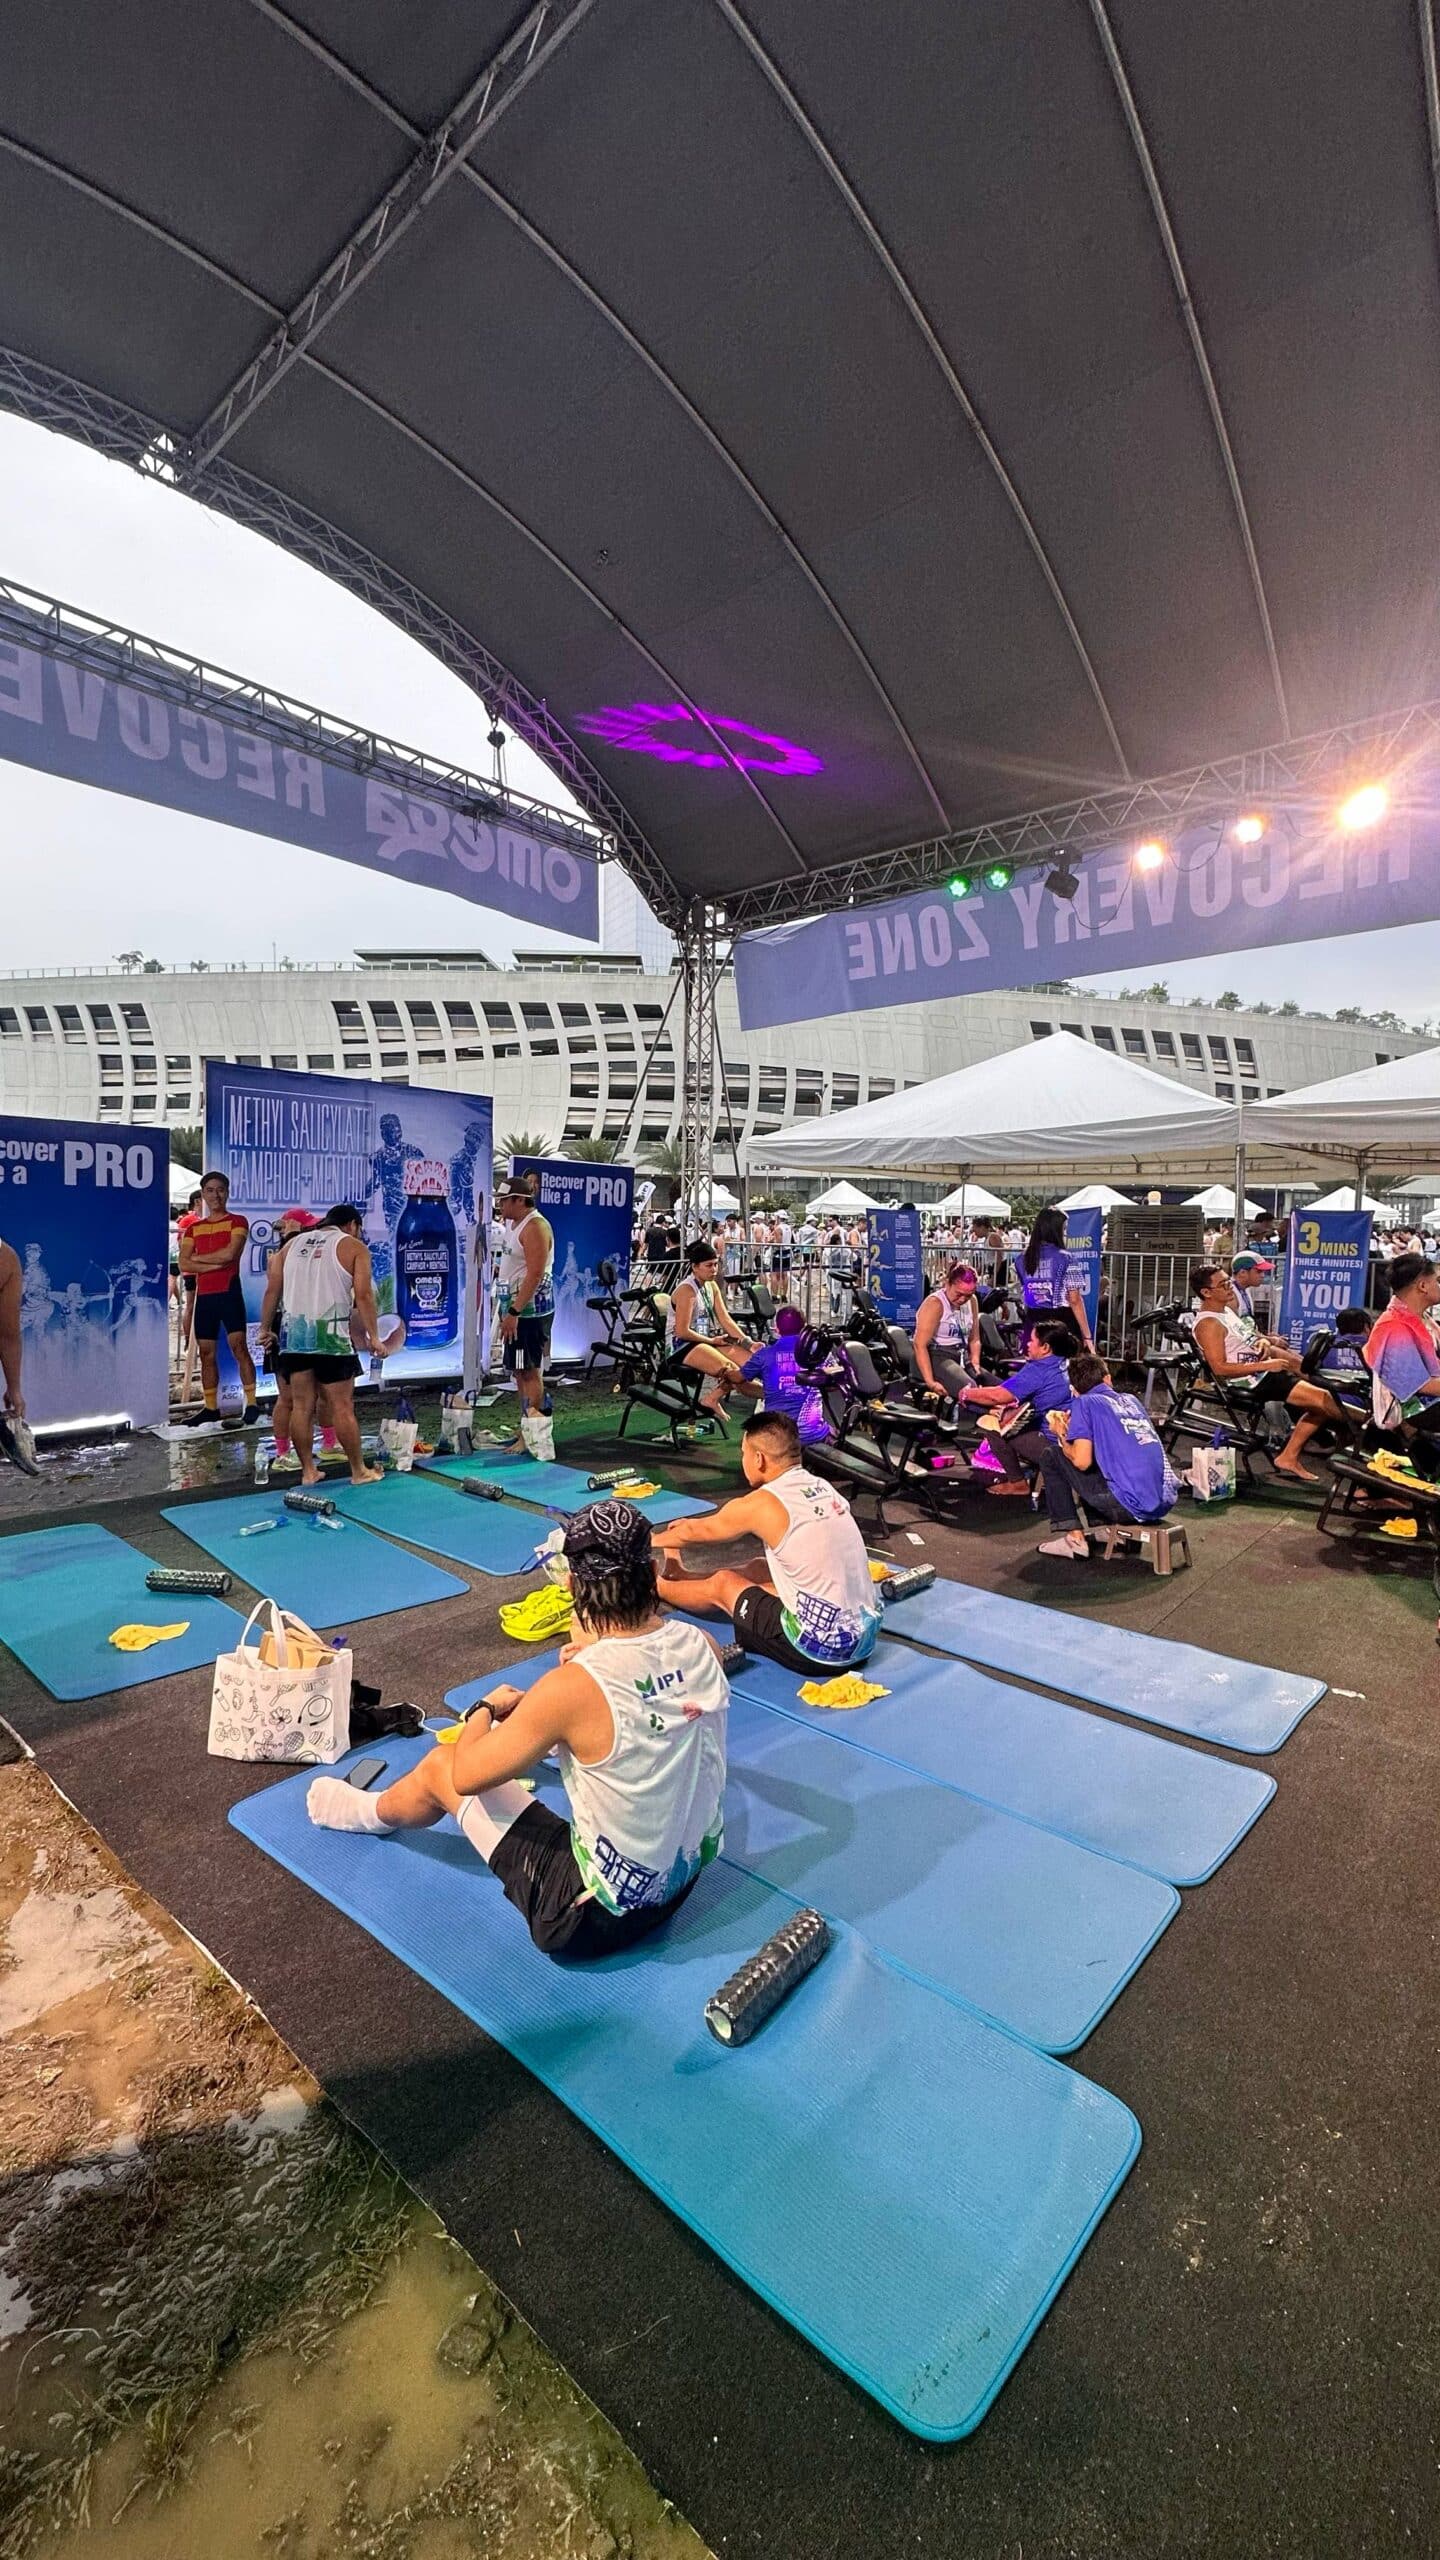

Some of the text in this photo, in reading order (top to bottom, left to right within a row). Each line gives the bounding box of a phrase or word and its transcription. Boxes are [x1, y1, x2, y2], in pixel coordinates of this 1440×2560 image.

[229, 1094, 370, 1153] METHYL SALICYLATE
[12, 1165, 28, 1185] a
[63, 1140, 154, 1190] PRO
[541, 1172, 585, 1190] Recover
[585, 1175, 628, 1208] PRO
[540, 1187, 571, 1205] like a
[1298, 1221, 1359, 1256] 3 MINS
[1322, 1259, 1363, 1269] MINUTES)
[1301, 1270, 1351, 1282] JUST FOR
[1299, 1283, 1351, 1310] YOU
[656, 1669, 684, 1690] IPI
